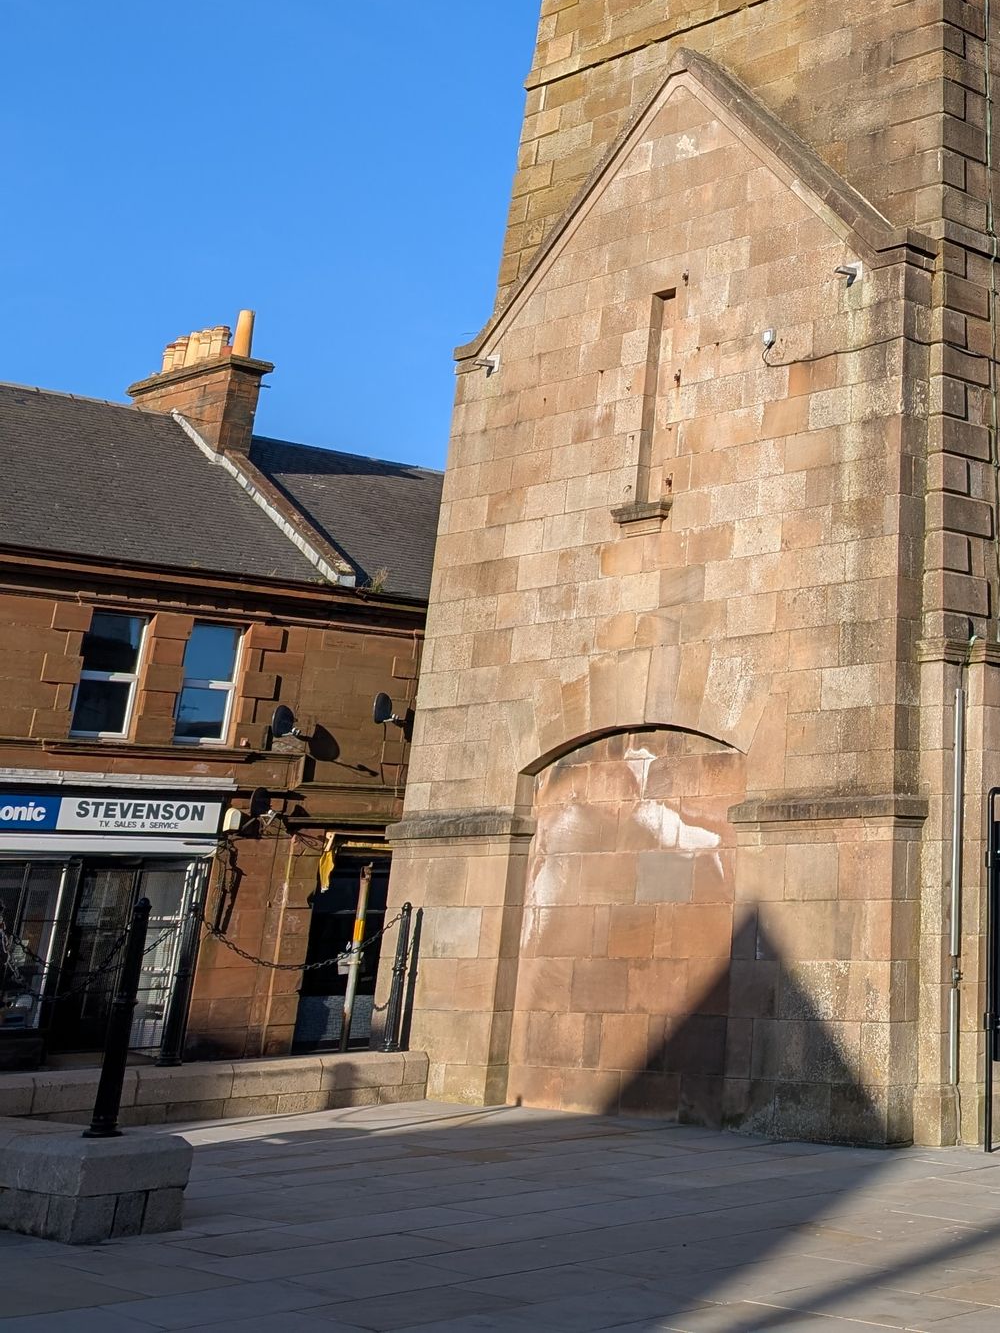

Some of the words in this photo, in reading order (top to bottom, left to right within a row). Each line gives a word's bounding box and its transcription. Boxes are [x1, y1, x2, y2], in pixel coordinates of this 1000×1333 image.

[0, 802, 46, 822] onic
[75, 800, 206, 821] STEVENSON
[99, 820, 111, 828] T.V.
[113, 820, 138, 828] SALES
